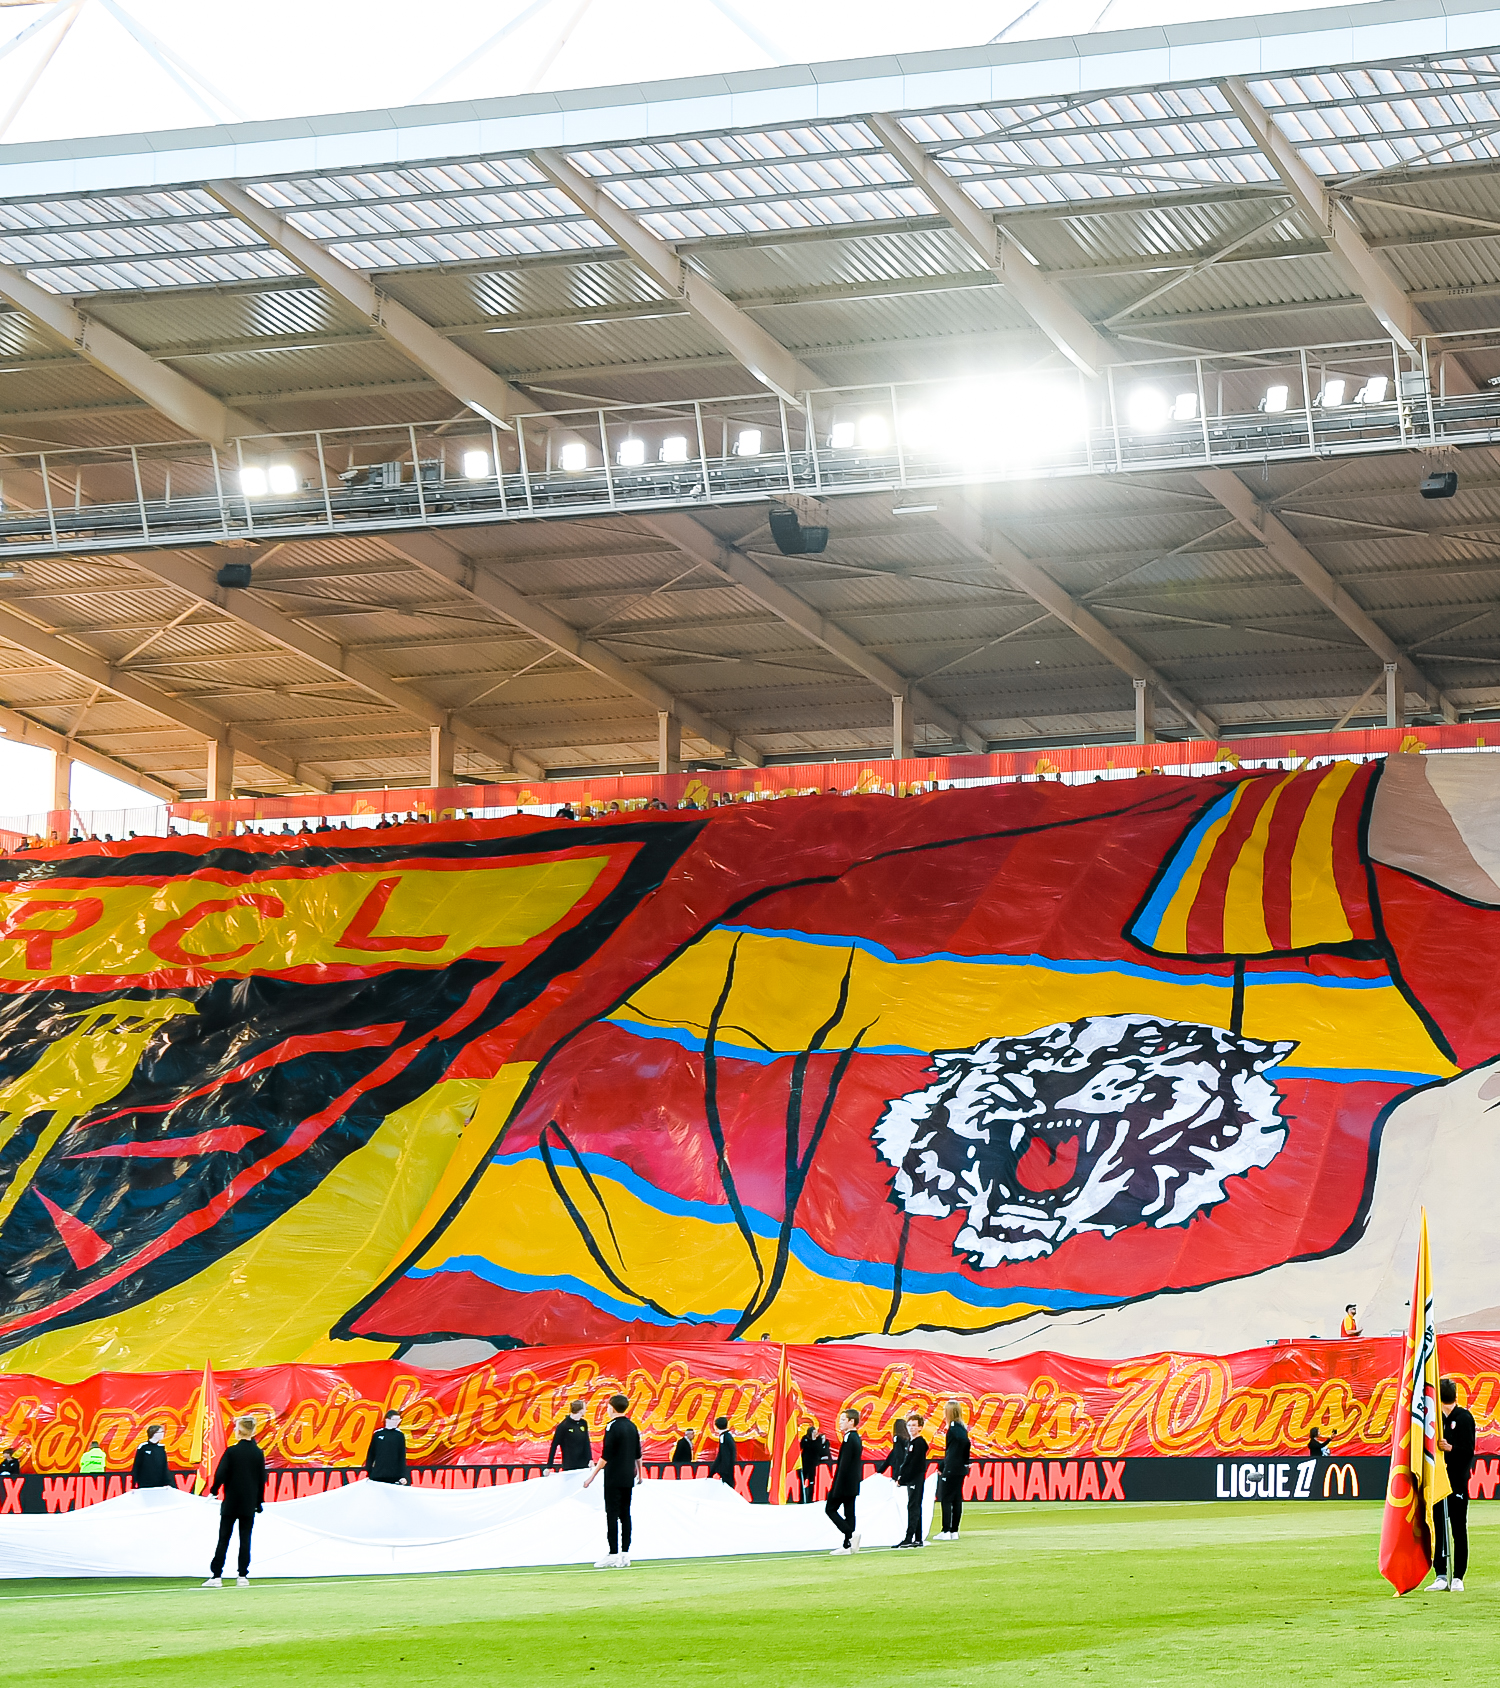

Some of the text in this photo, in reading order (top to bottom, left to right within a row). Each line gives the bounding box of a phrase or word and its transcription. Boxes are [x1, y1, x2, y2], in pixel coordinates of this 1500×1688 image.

[441, 1362, 819, 1462] historiqu
[961, 1460, 1126, 1501] WINAMAX
[1216, 1463, 1291, 1498] LIGUE
